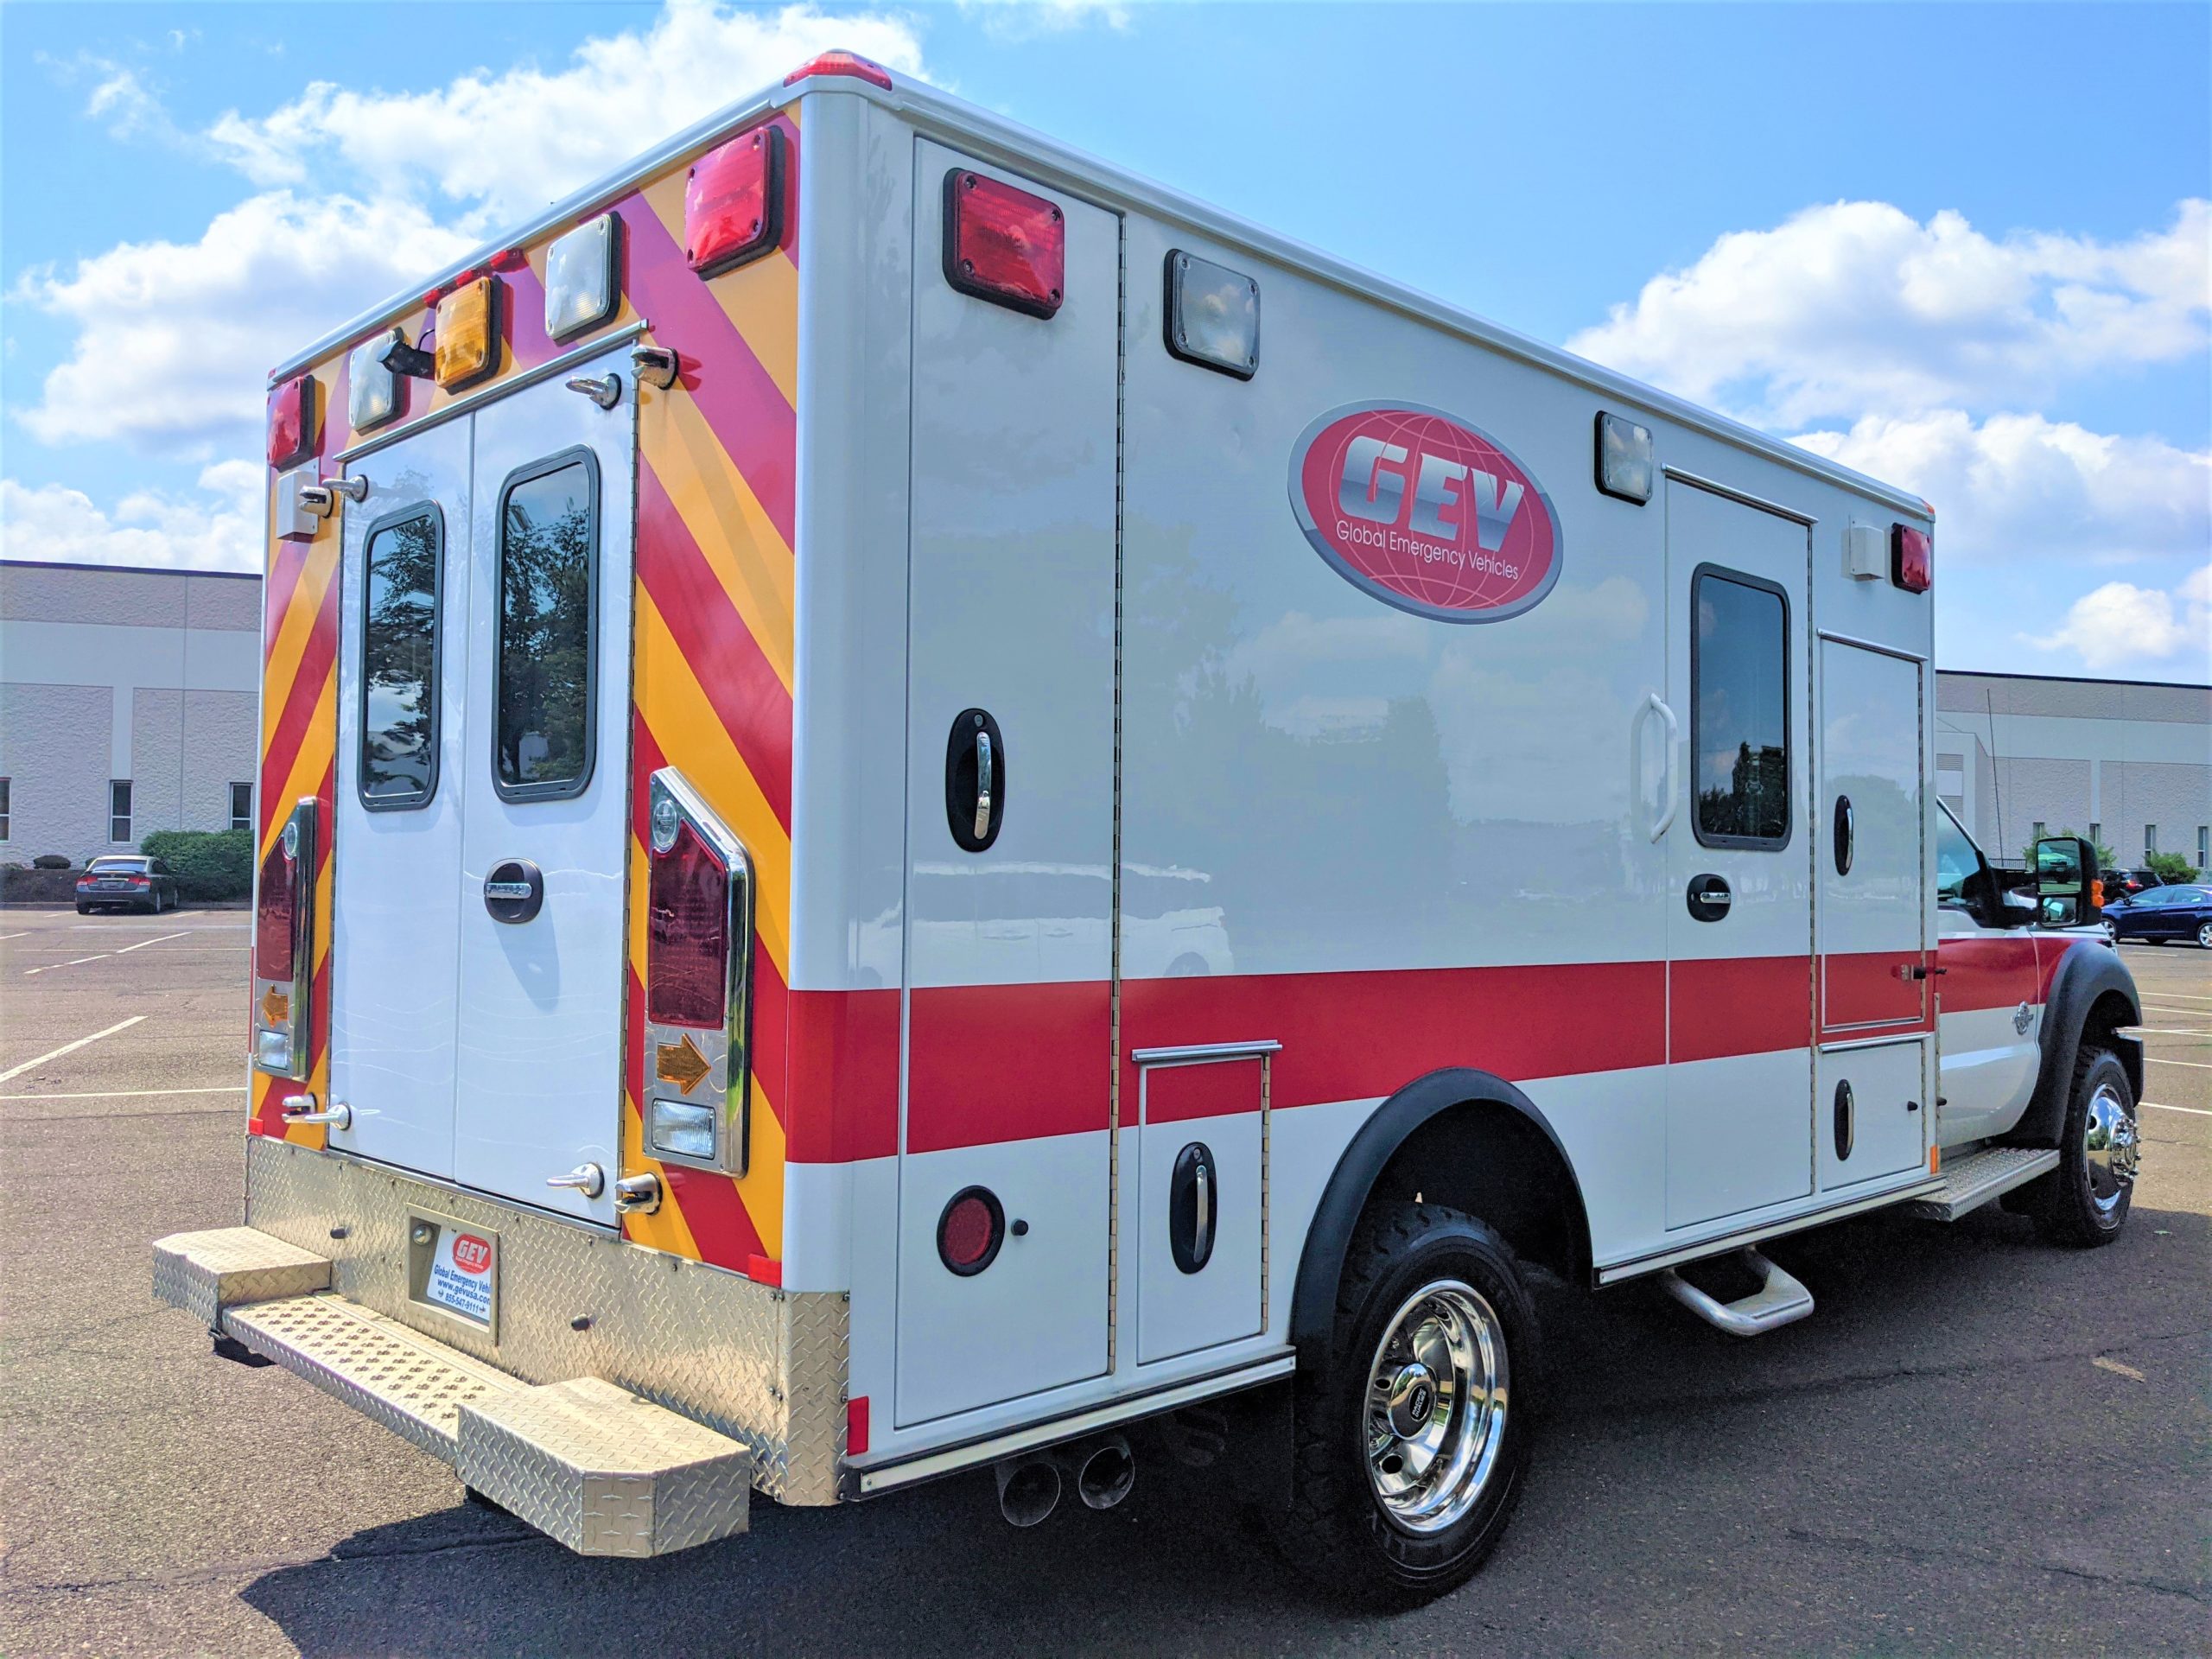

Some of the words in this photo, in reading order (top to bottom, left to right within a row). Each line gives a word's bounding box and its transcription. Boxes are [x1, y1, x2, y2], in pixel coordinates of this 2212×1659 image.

[1338, 435, 1525, 552] GEV
[1336, 520, 1386, 548] Global
[1389, 531, 1466, 570] Emergency
[1468, 550, 1519, 580] Vehicles
[457, 1239, 488, 1264] GEV
[434, 1264, 450, 1279] Global
[450, 1270, 478, 1292] Emergency
